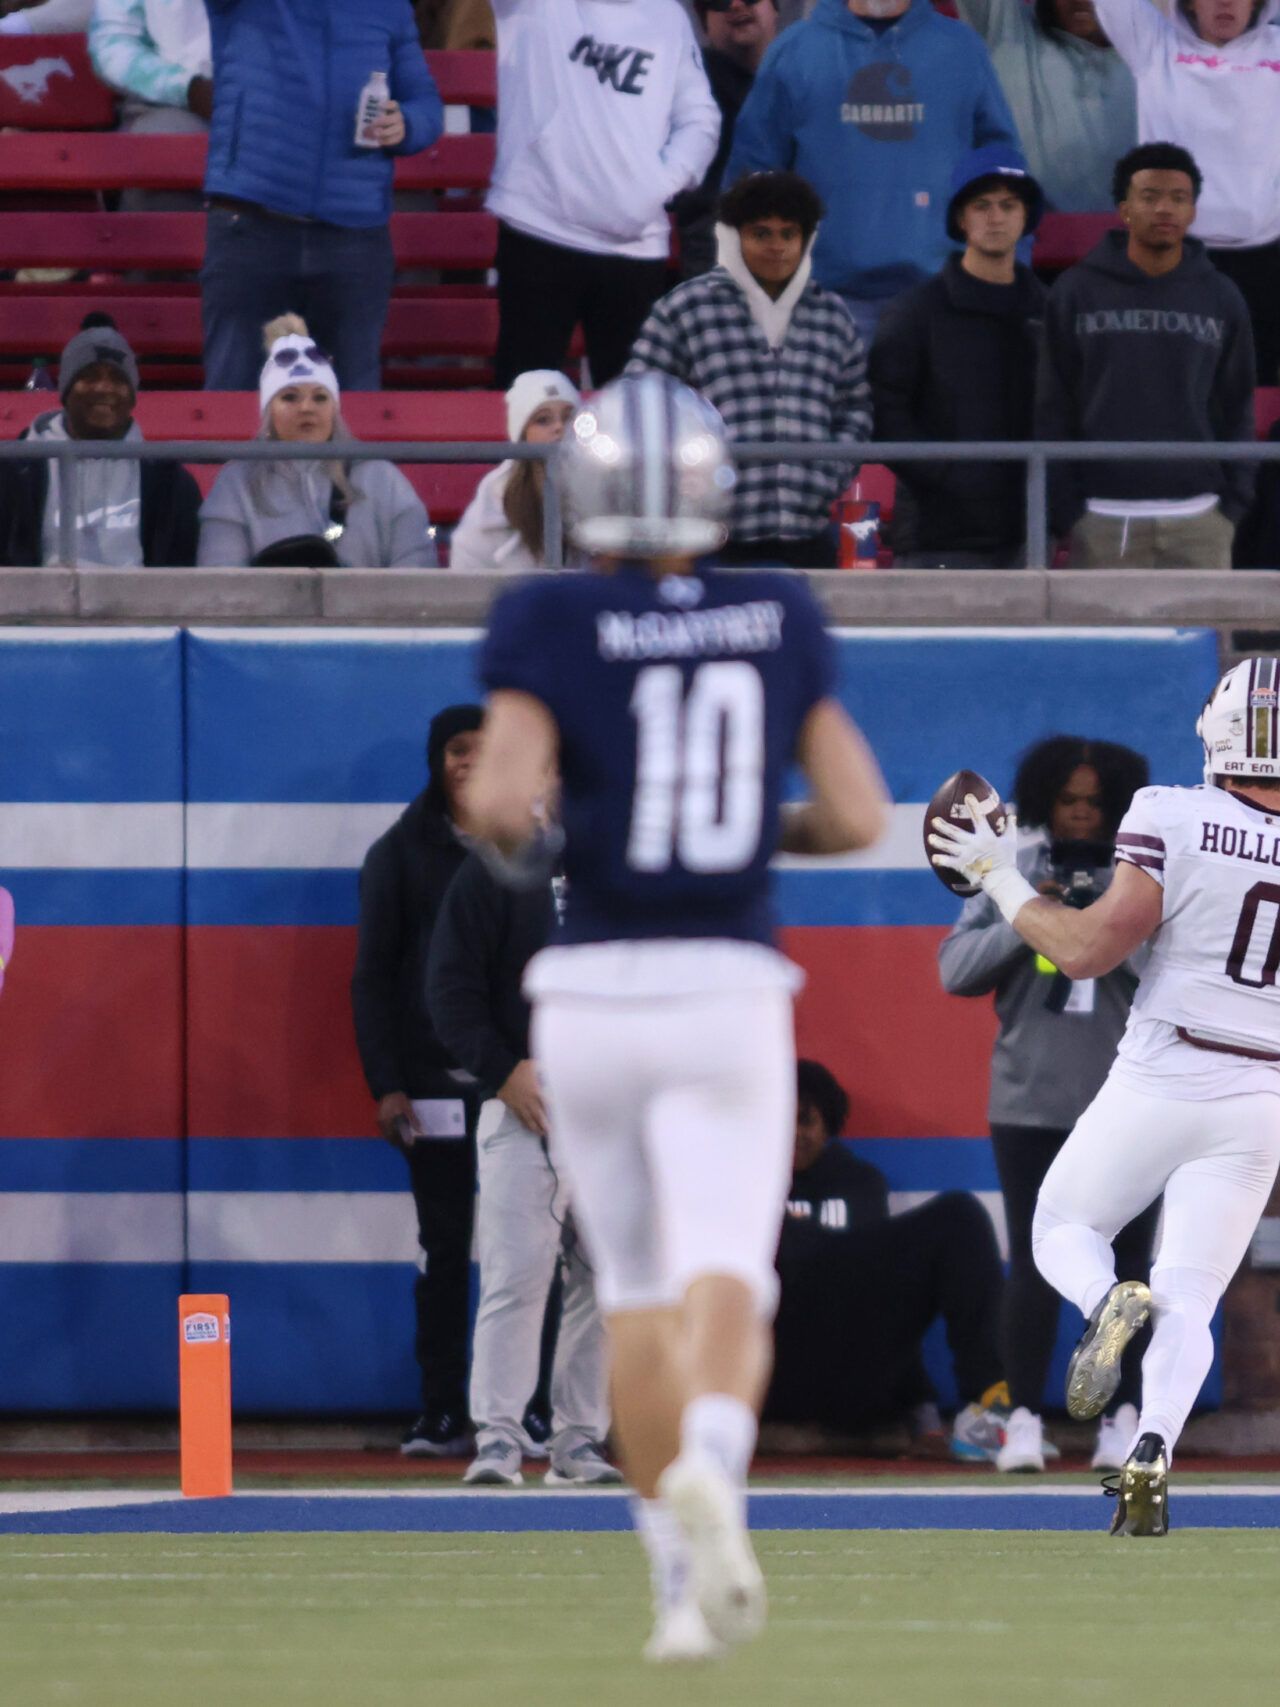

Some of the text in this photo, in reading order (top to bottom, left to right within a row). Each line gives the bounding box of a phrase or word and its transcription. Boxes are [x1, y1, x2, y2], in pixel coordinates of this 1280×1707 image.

[1076, 309, 1225, 343] HOMETOWN
[626, 661, 765, 873] 10
[1224, 761, 1246, 771] EAT
